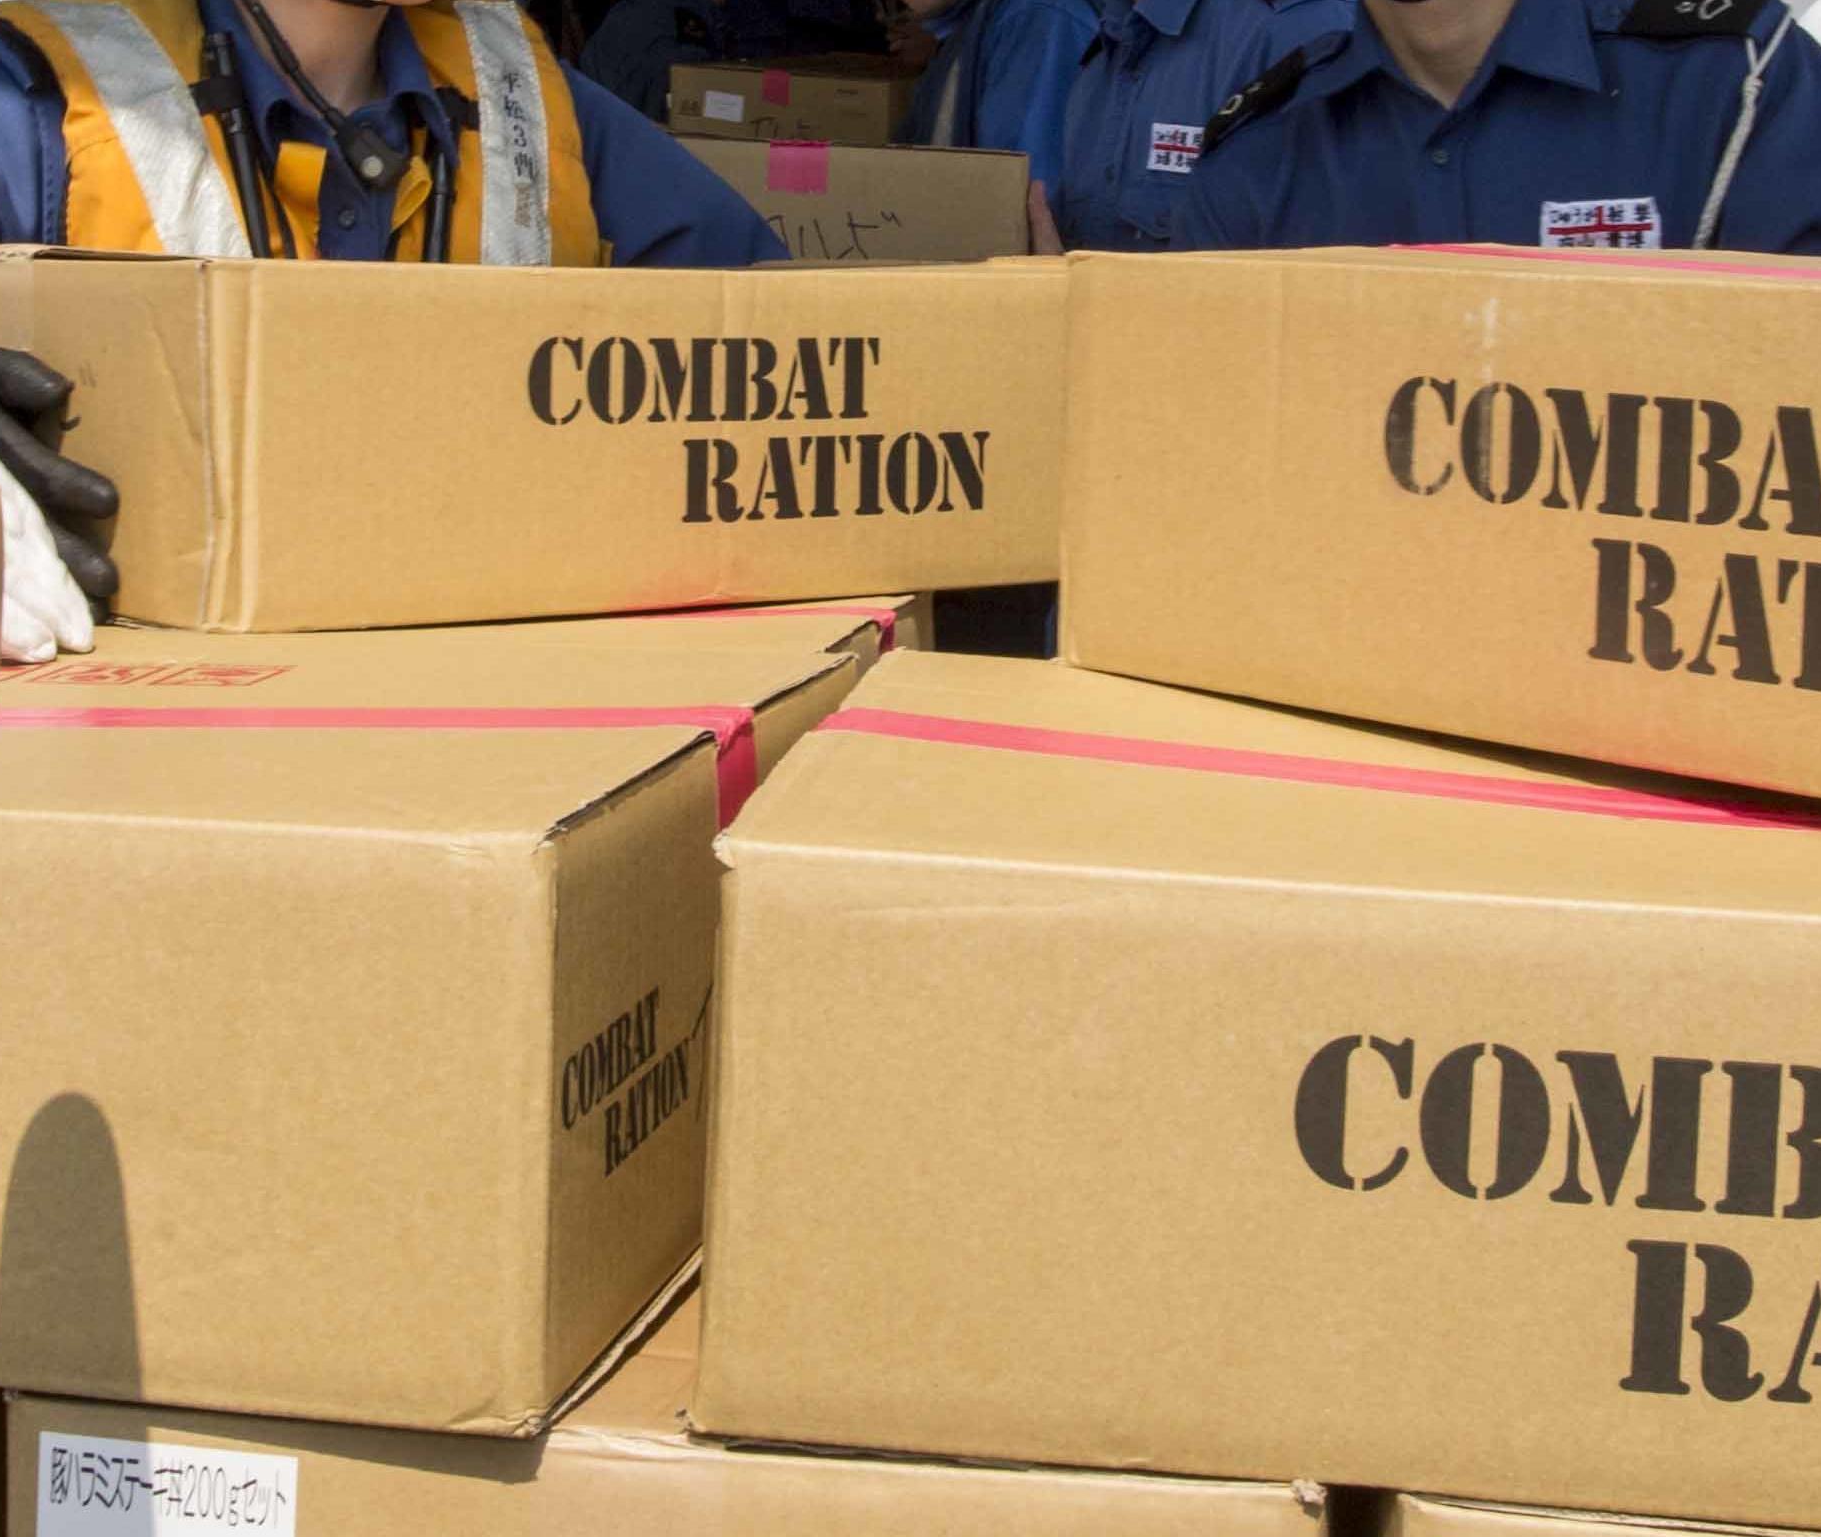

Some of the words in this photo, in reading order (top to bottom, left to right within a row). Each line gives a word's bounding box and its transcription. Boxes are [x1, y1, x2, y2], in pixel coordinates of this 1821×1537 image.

[528, 336, 881, 426] COMBAT
[681, 431, 990, 523] RATION
[561, 985, 659, 1131] COMBAT
[604, 1037, 690, 1178] RATION
